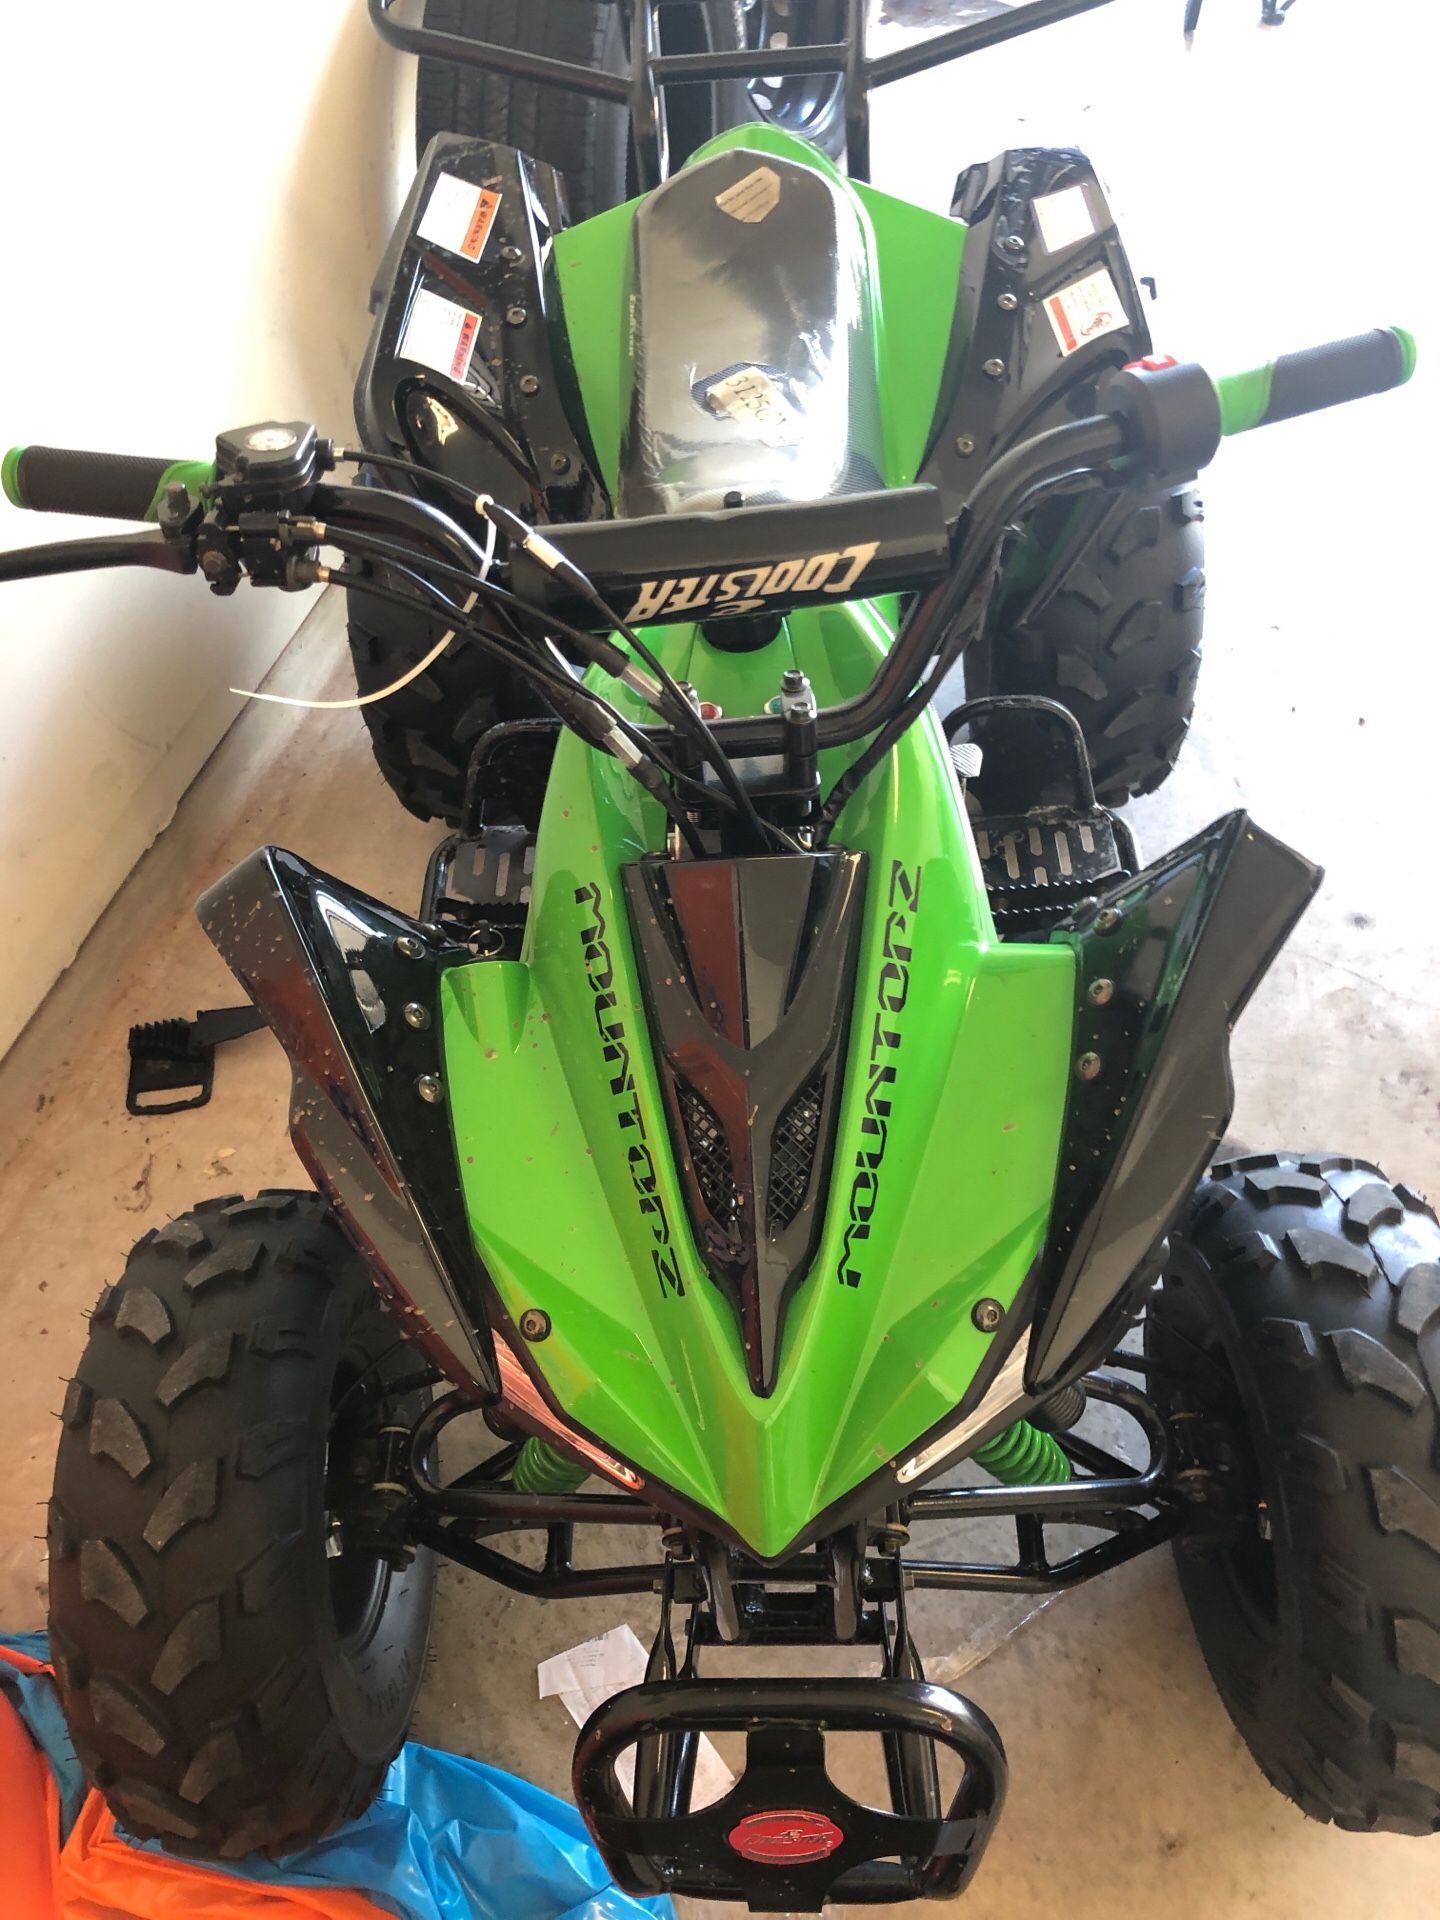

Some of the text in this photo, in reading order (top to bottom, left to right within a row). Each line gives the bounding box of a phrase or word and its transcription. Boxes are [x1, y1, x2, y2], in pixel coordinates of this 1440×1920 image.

[623, 541, 881, 623] COOLSTER
[574, 881, 686, 1299] MOUNTOPZ
[835, 859, 921, 1288] MOUNTOPZ
